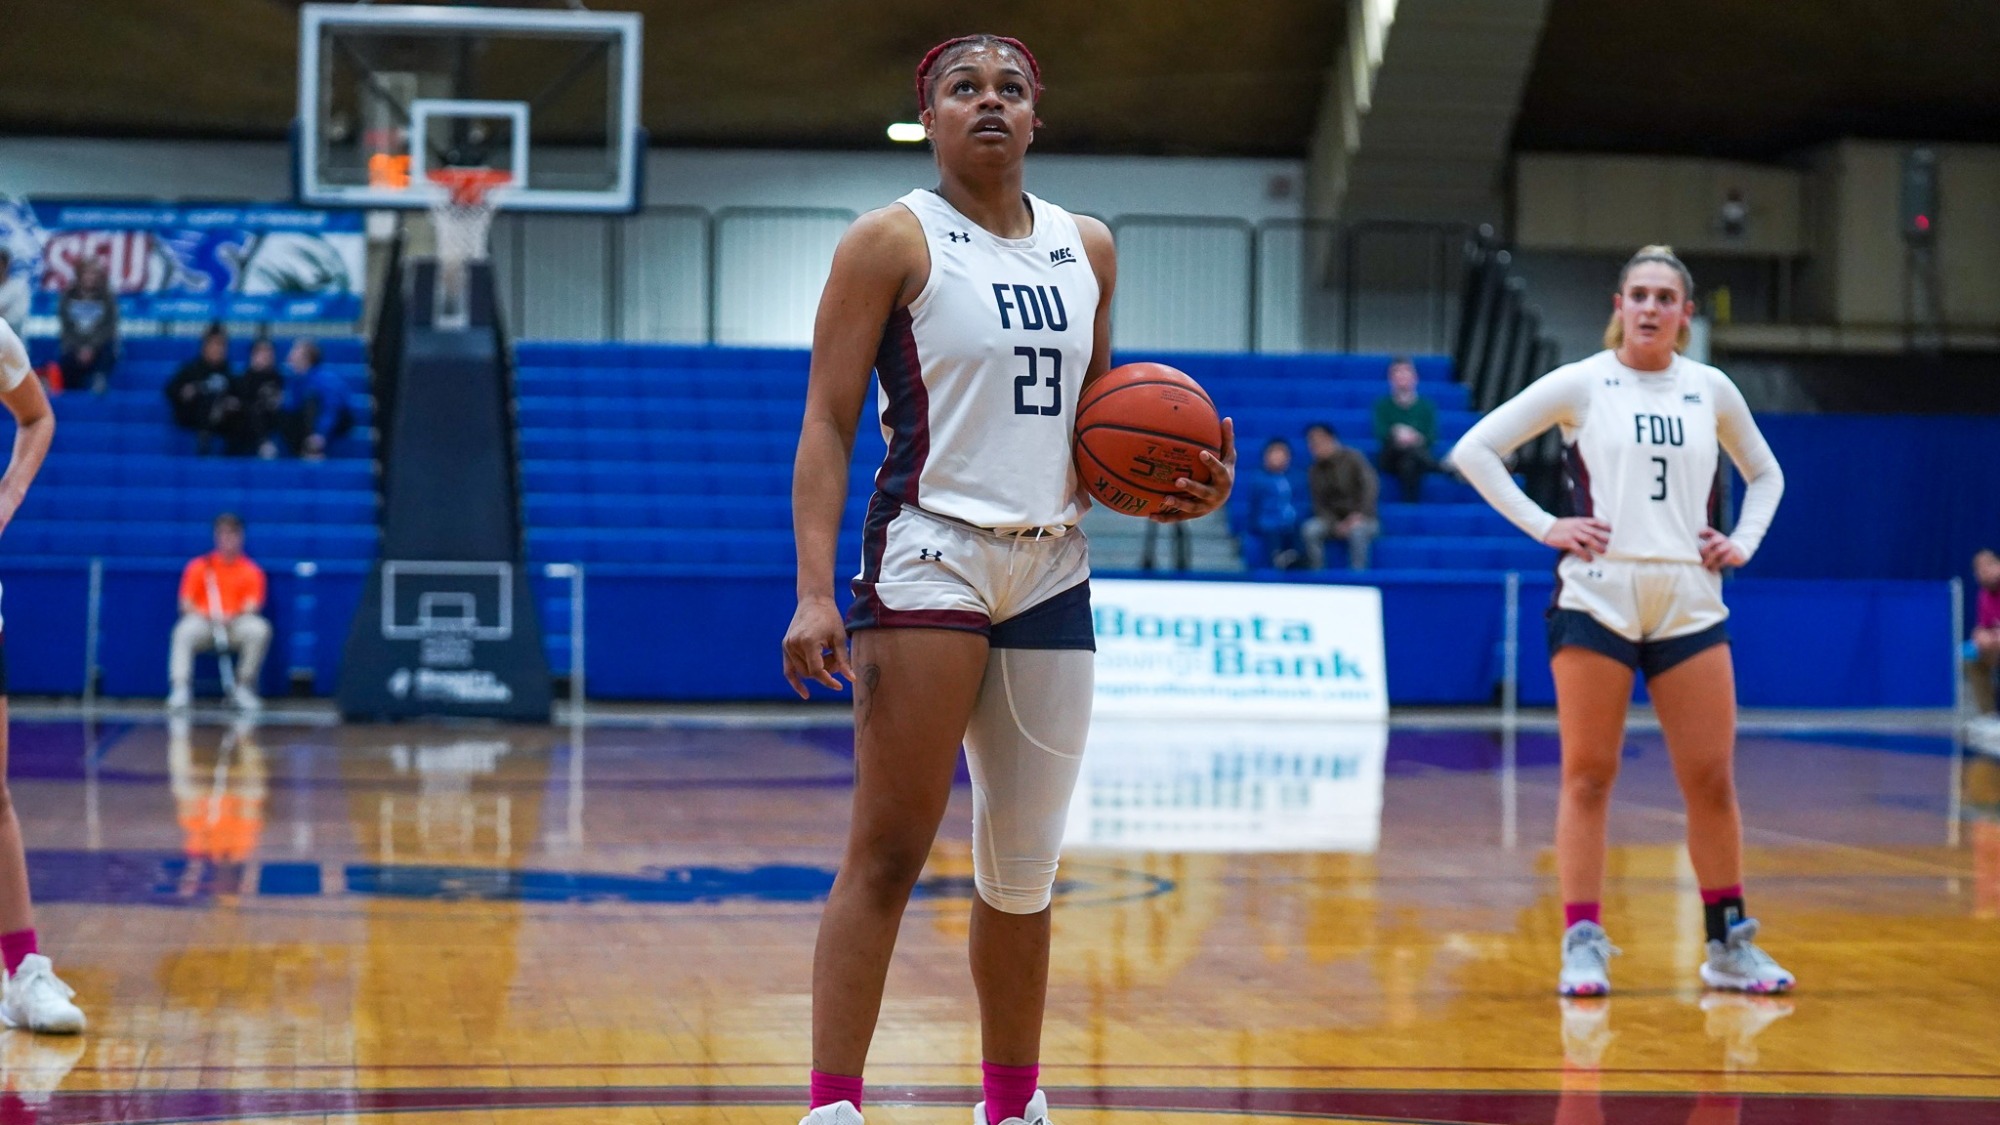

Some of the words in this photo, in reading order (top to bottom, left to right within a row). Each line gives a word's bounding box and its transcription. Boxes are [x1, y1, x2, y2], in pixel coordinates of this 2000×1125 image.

[1050, 247, 1072, 263] NEC
[992, 283, 1068, 332] FDU
[1014, 346, 1063, 417] 23
[1635, 414, 1684, 446] FDU
[1650, 457, 1667, 501] 3
[1092, 605, 1312, 647] Bogota
[1212, 645, 1366, 678] Bank
